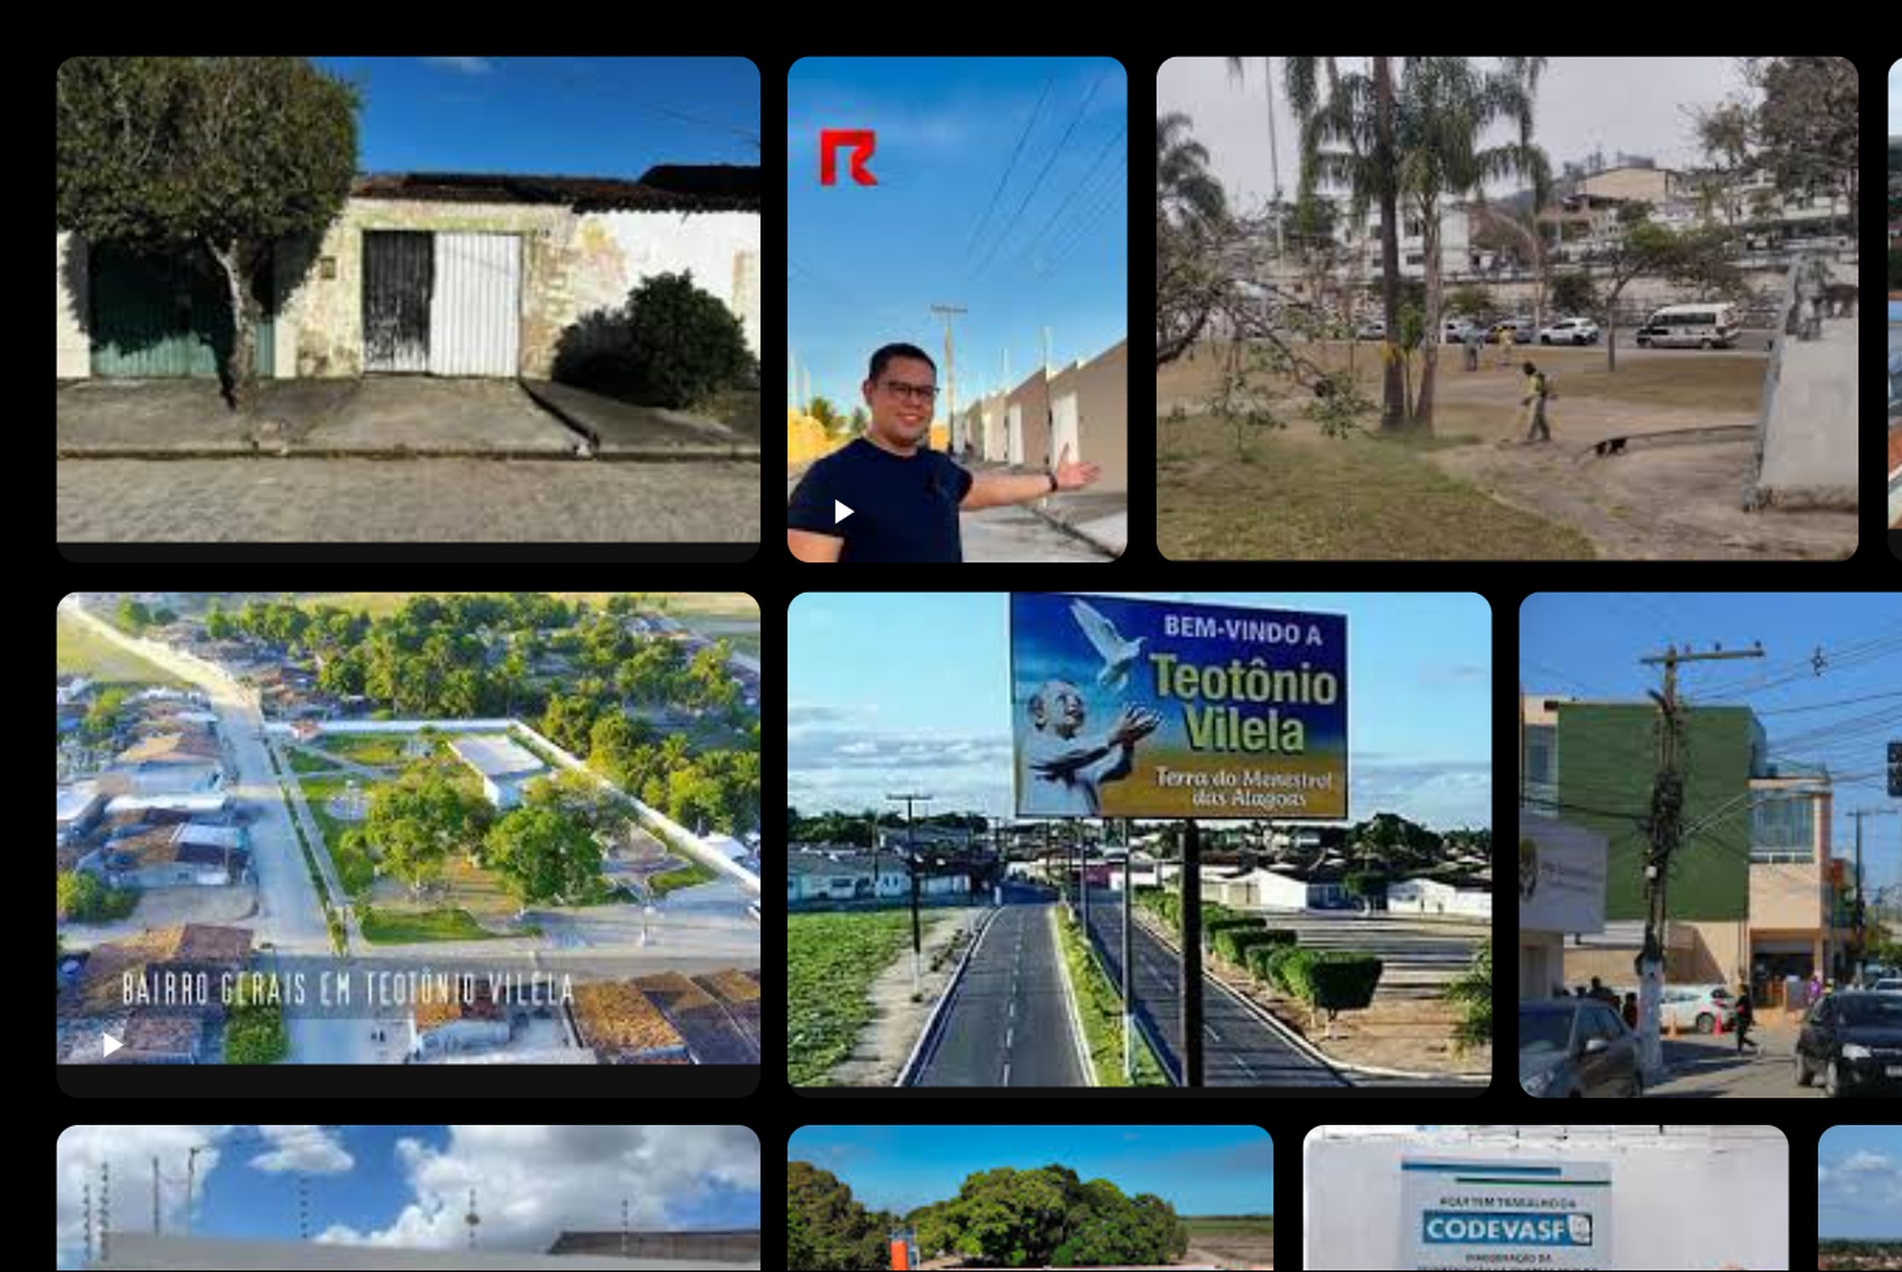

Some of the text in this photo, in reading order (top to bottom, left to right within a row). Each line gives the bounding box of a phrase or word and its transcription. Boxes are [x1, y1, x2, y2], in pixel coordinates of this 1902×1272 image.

[1164, 614, 1323, 646] BEM-VINDO A
[1149, 652, 1338, 705] Teotônio
[1184, 703, 1304, 750] Vilela
[1155, 766, 1332, 790] Terra do Menestrel
[1193, 788, 1307, 811] das Alagoas
[1427, 1218, 1566, 1241] CODEVASF
